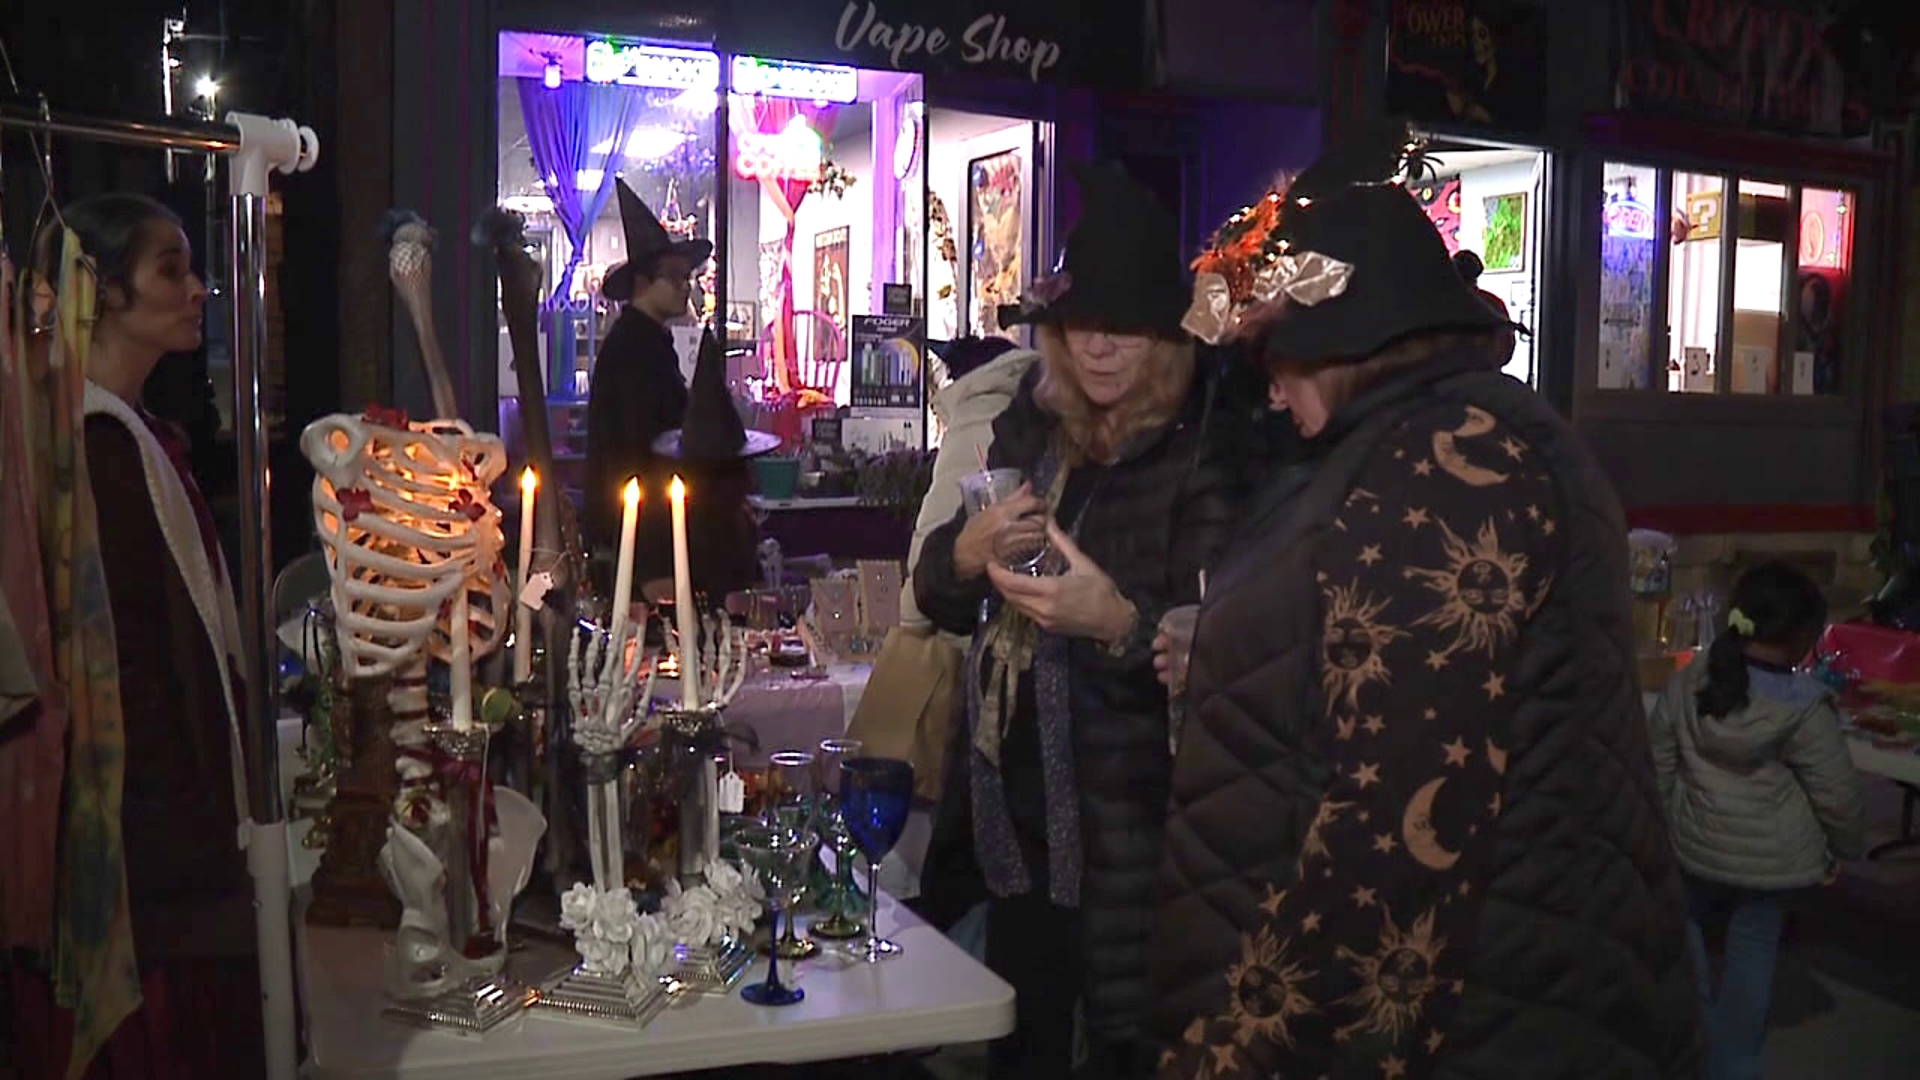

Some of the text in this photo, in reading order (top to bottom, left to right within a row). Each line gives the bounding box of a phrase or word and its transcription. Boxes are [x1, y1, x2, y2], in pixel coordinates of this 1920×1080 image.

[835, 0, 1061, 84] Vape Shop
[1603, 206, 1654, 232] OPEN
